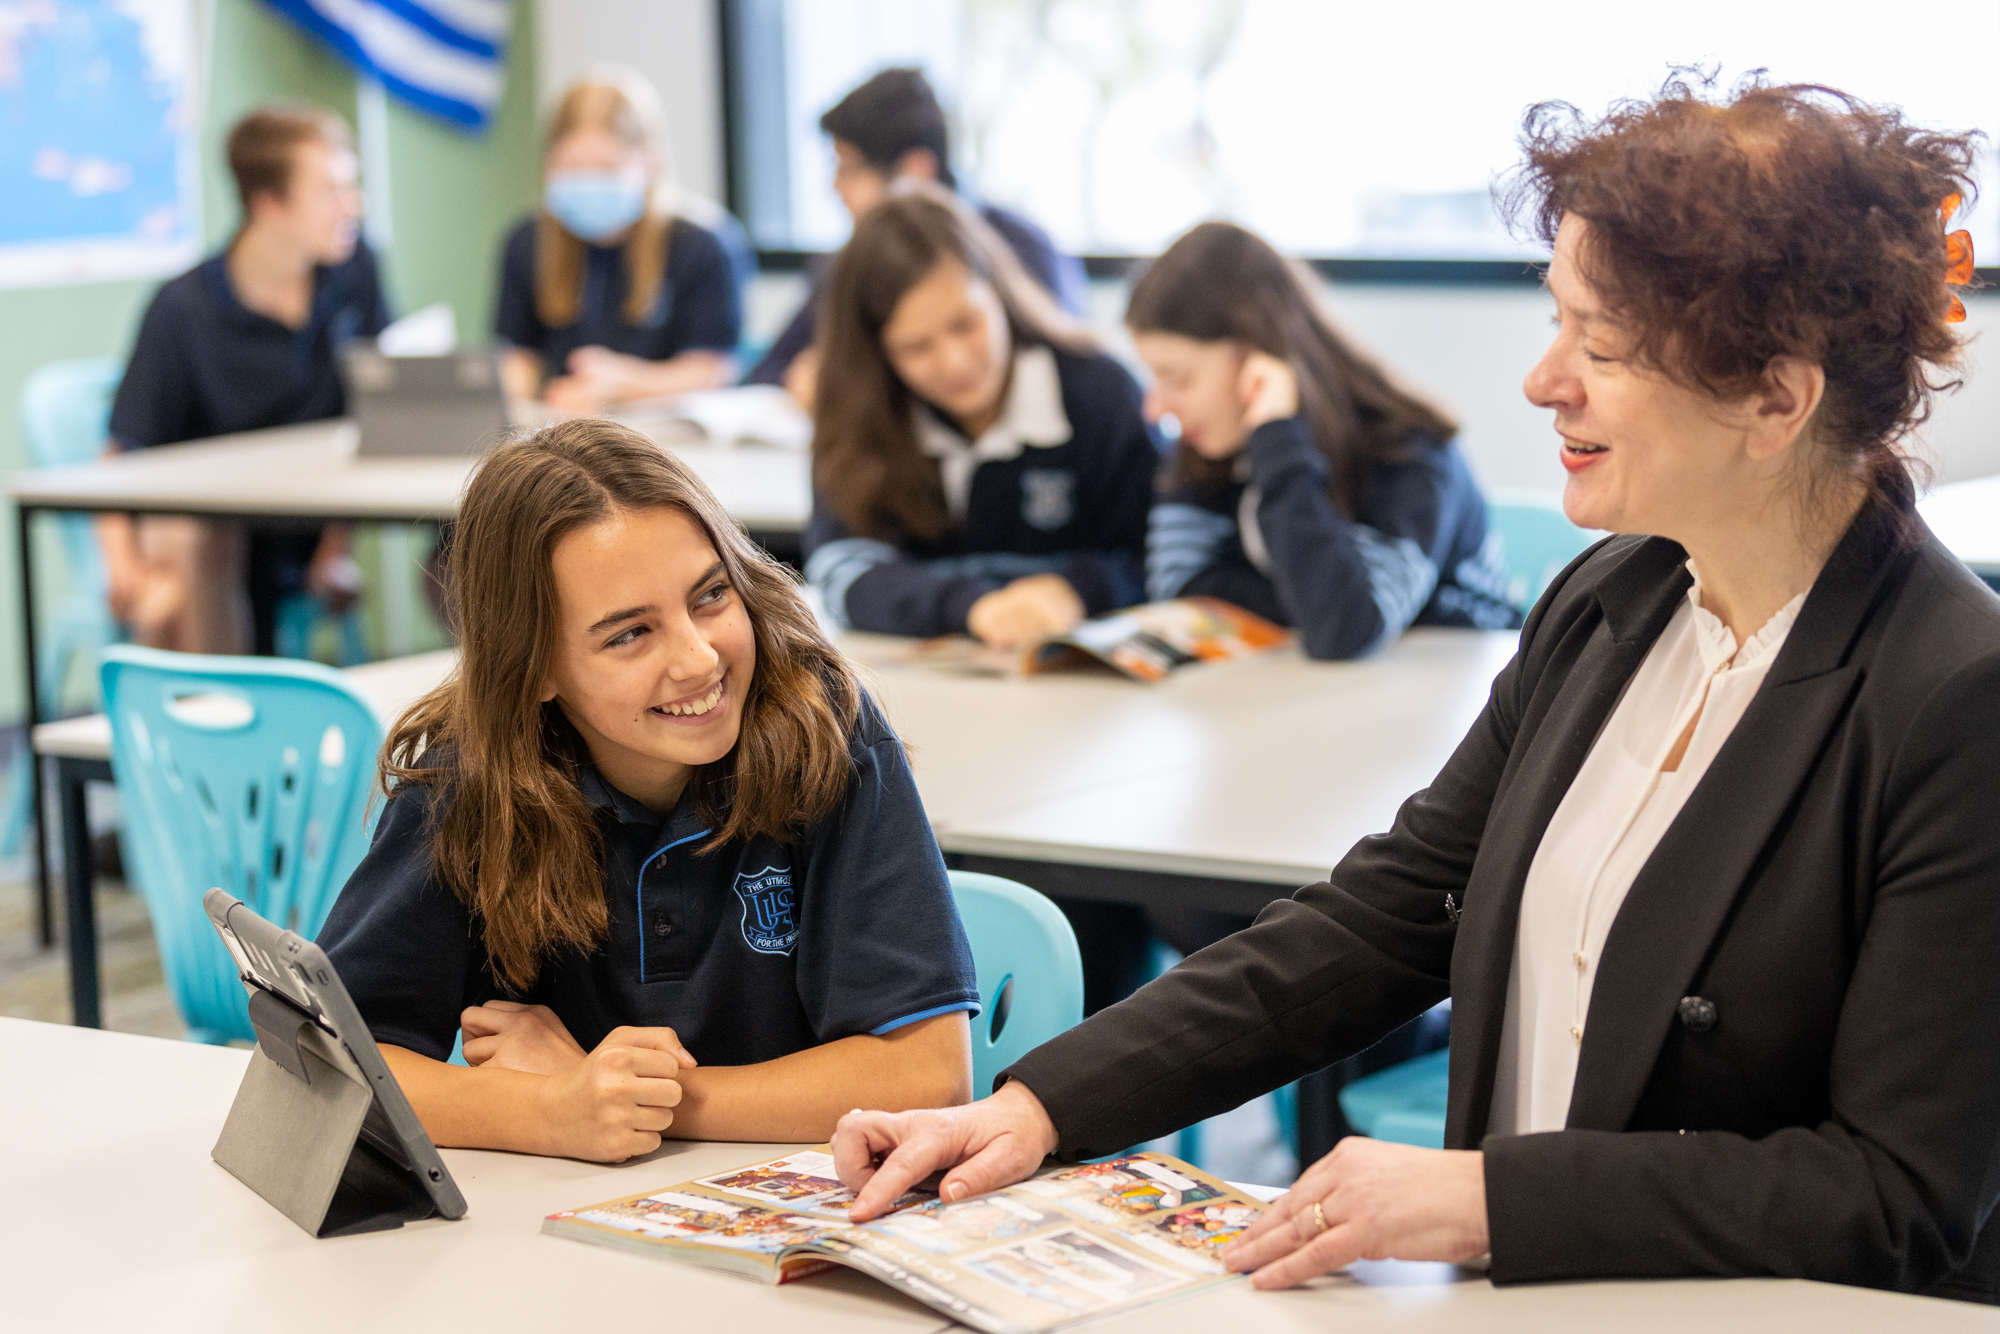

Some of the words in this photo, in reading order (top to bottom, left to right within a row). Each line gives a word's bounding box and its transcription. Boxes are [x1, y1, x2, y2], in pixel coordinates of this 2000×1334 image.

[746, 881, 764, 893] THE
[765, 876, 791, 886] UTMOS
[756, 938, 771, 948] FOR
[772, 938, 784, 948] THE
